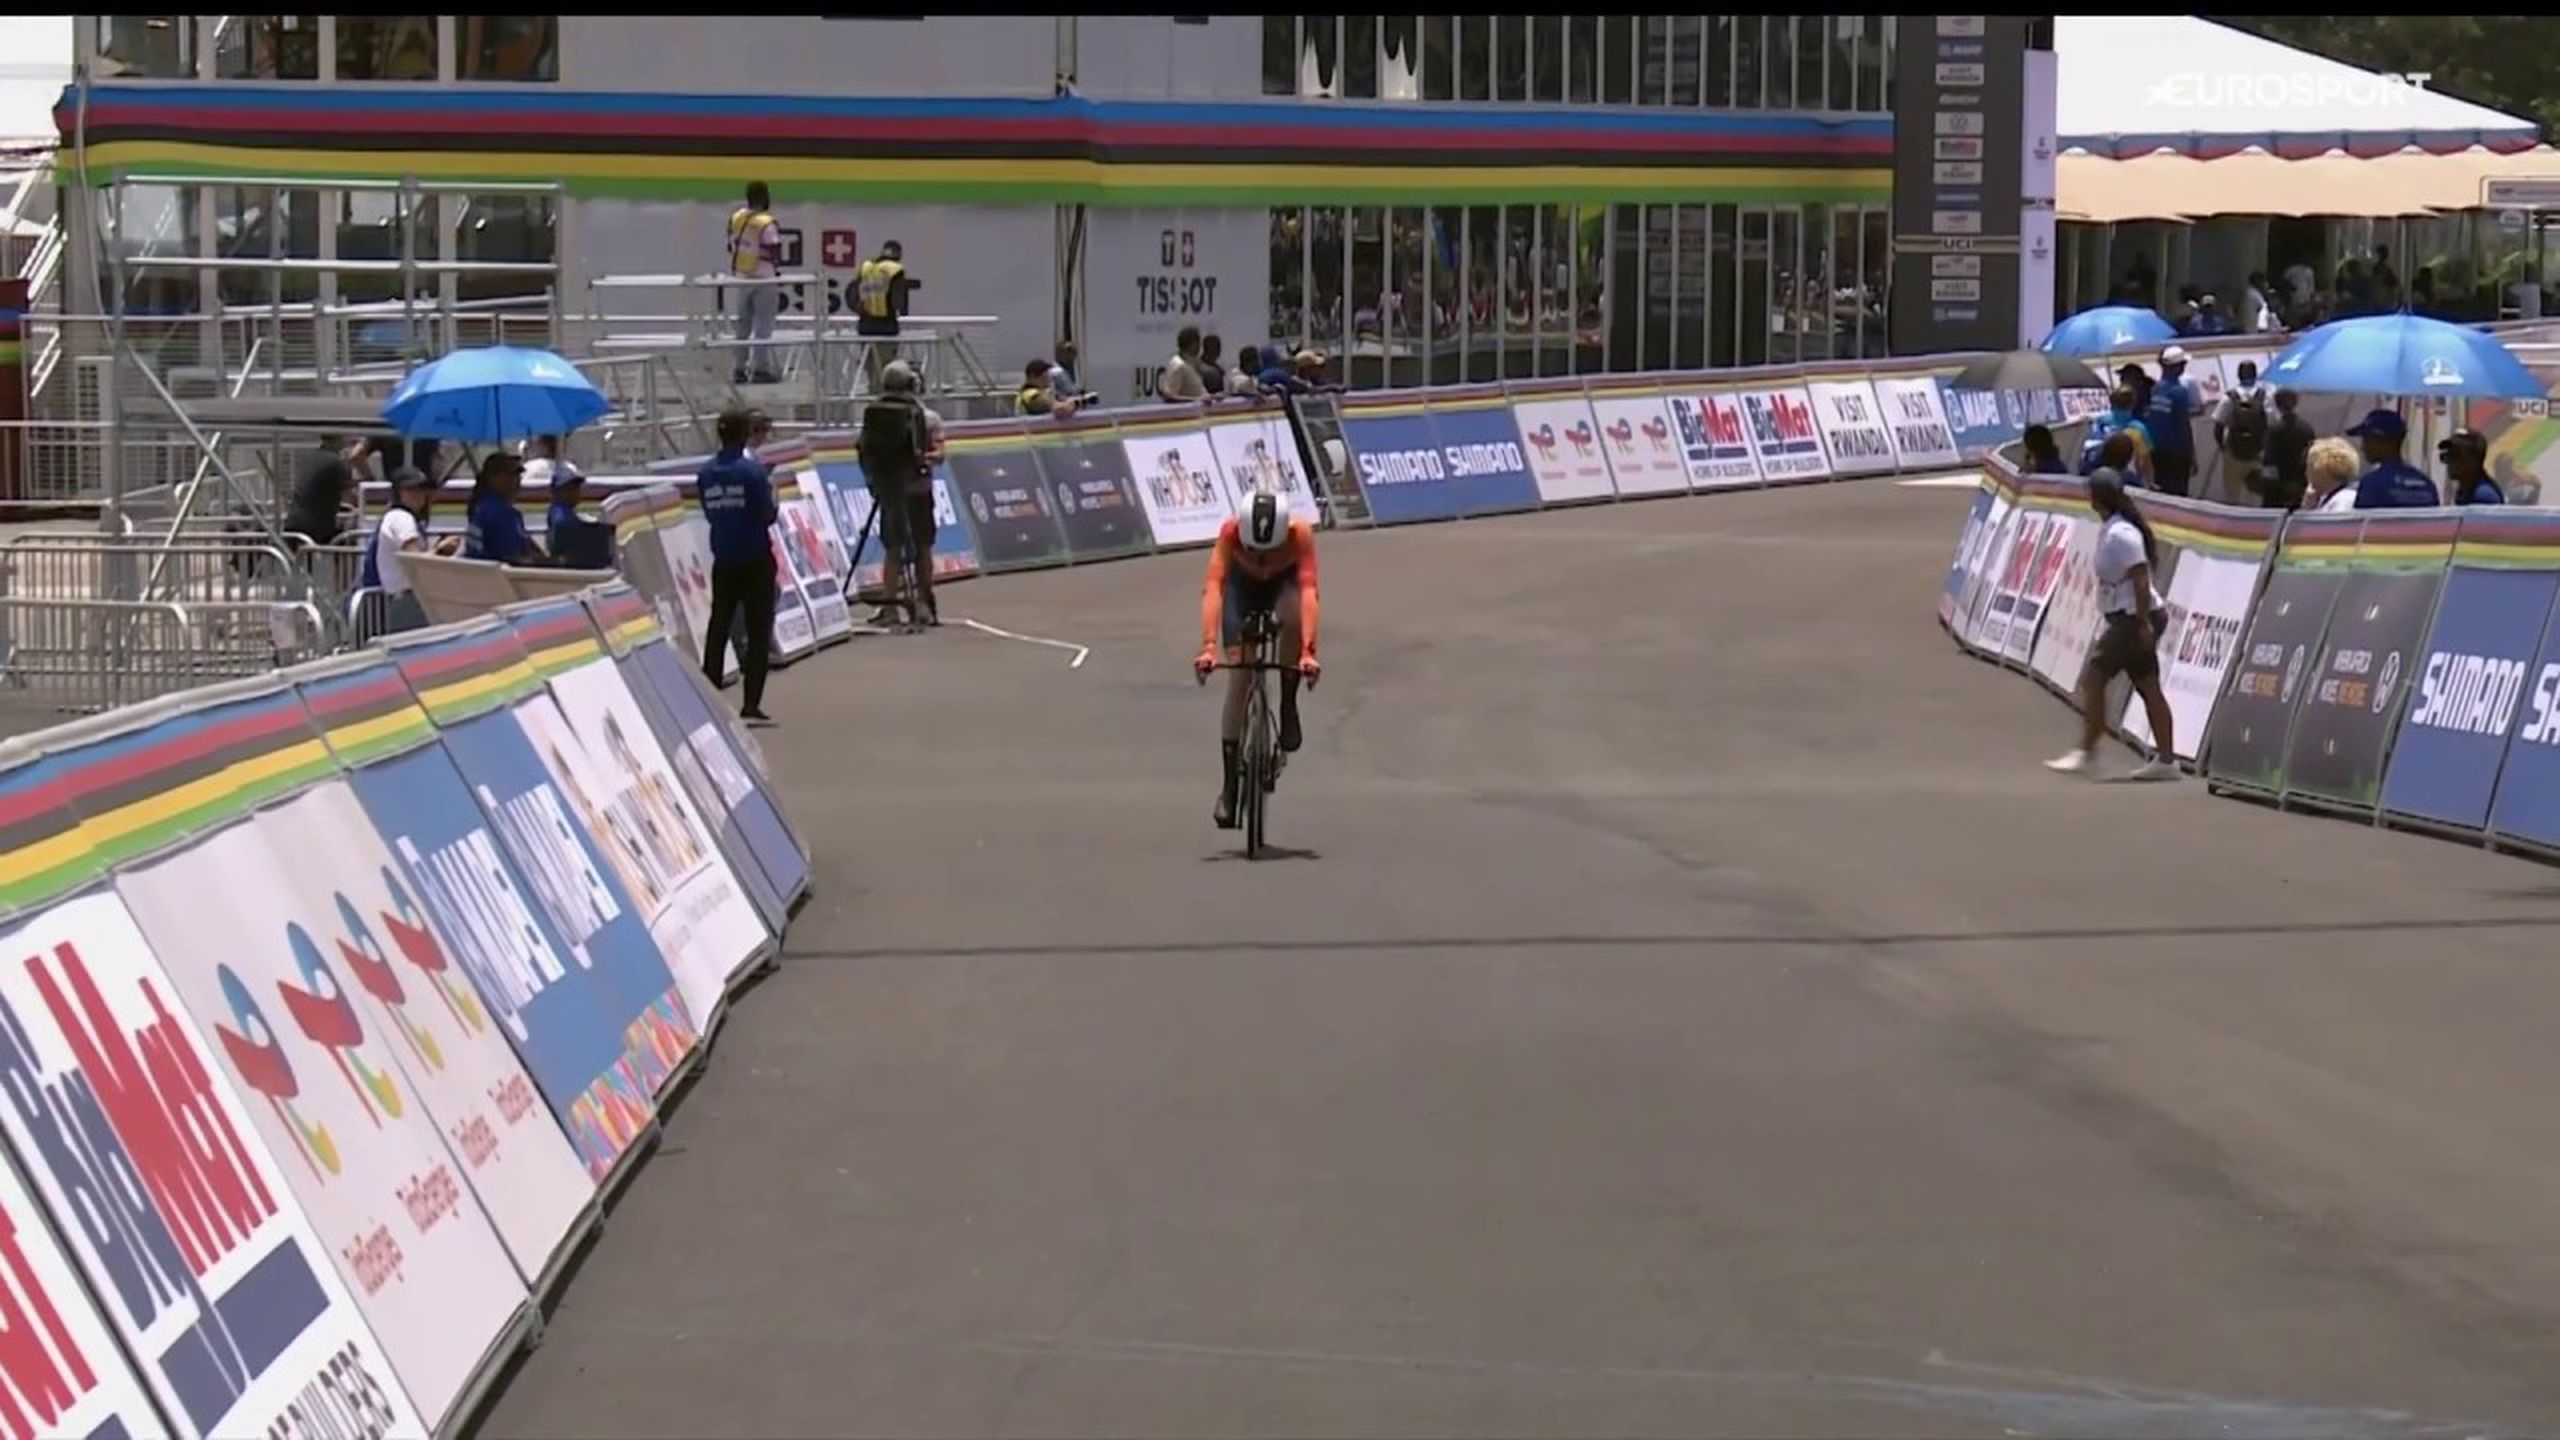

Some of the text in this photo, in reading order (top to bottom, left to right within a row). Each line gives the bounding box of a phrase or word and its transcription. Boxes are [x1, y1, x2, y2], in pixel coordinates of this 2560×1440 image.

[1943, 239, 1974, 250] UCI
[1136, 276, 1217, 314] TISSOT
[1143, 367, 1167, 397] UC
[1831, 394, 1868, 423] VISIT
[1897, 391, 1933, 419] VISIT
[2519, 401, 2547, 416] UCI
[1672, 398, 1744, 459] BigMat
[1745, 393, 1814, 454] BigMat
[1895, 423, 1953, 453] RWANDA
[1829, 427, 1890, 458] RWANDA
[1359, 449, 1445, 485] SHIMANO
[1445, 442, 1524, 477] SHIMANO
[2411, 652, 2526, 737] SHIMANO
